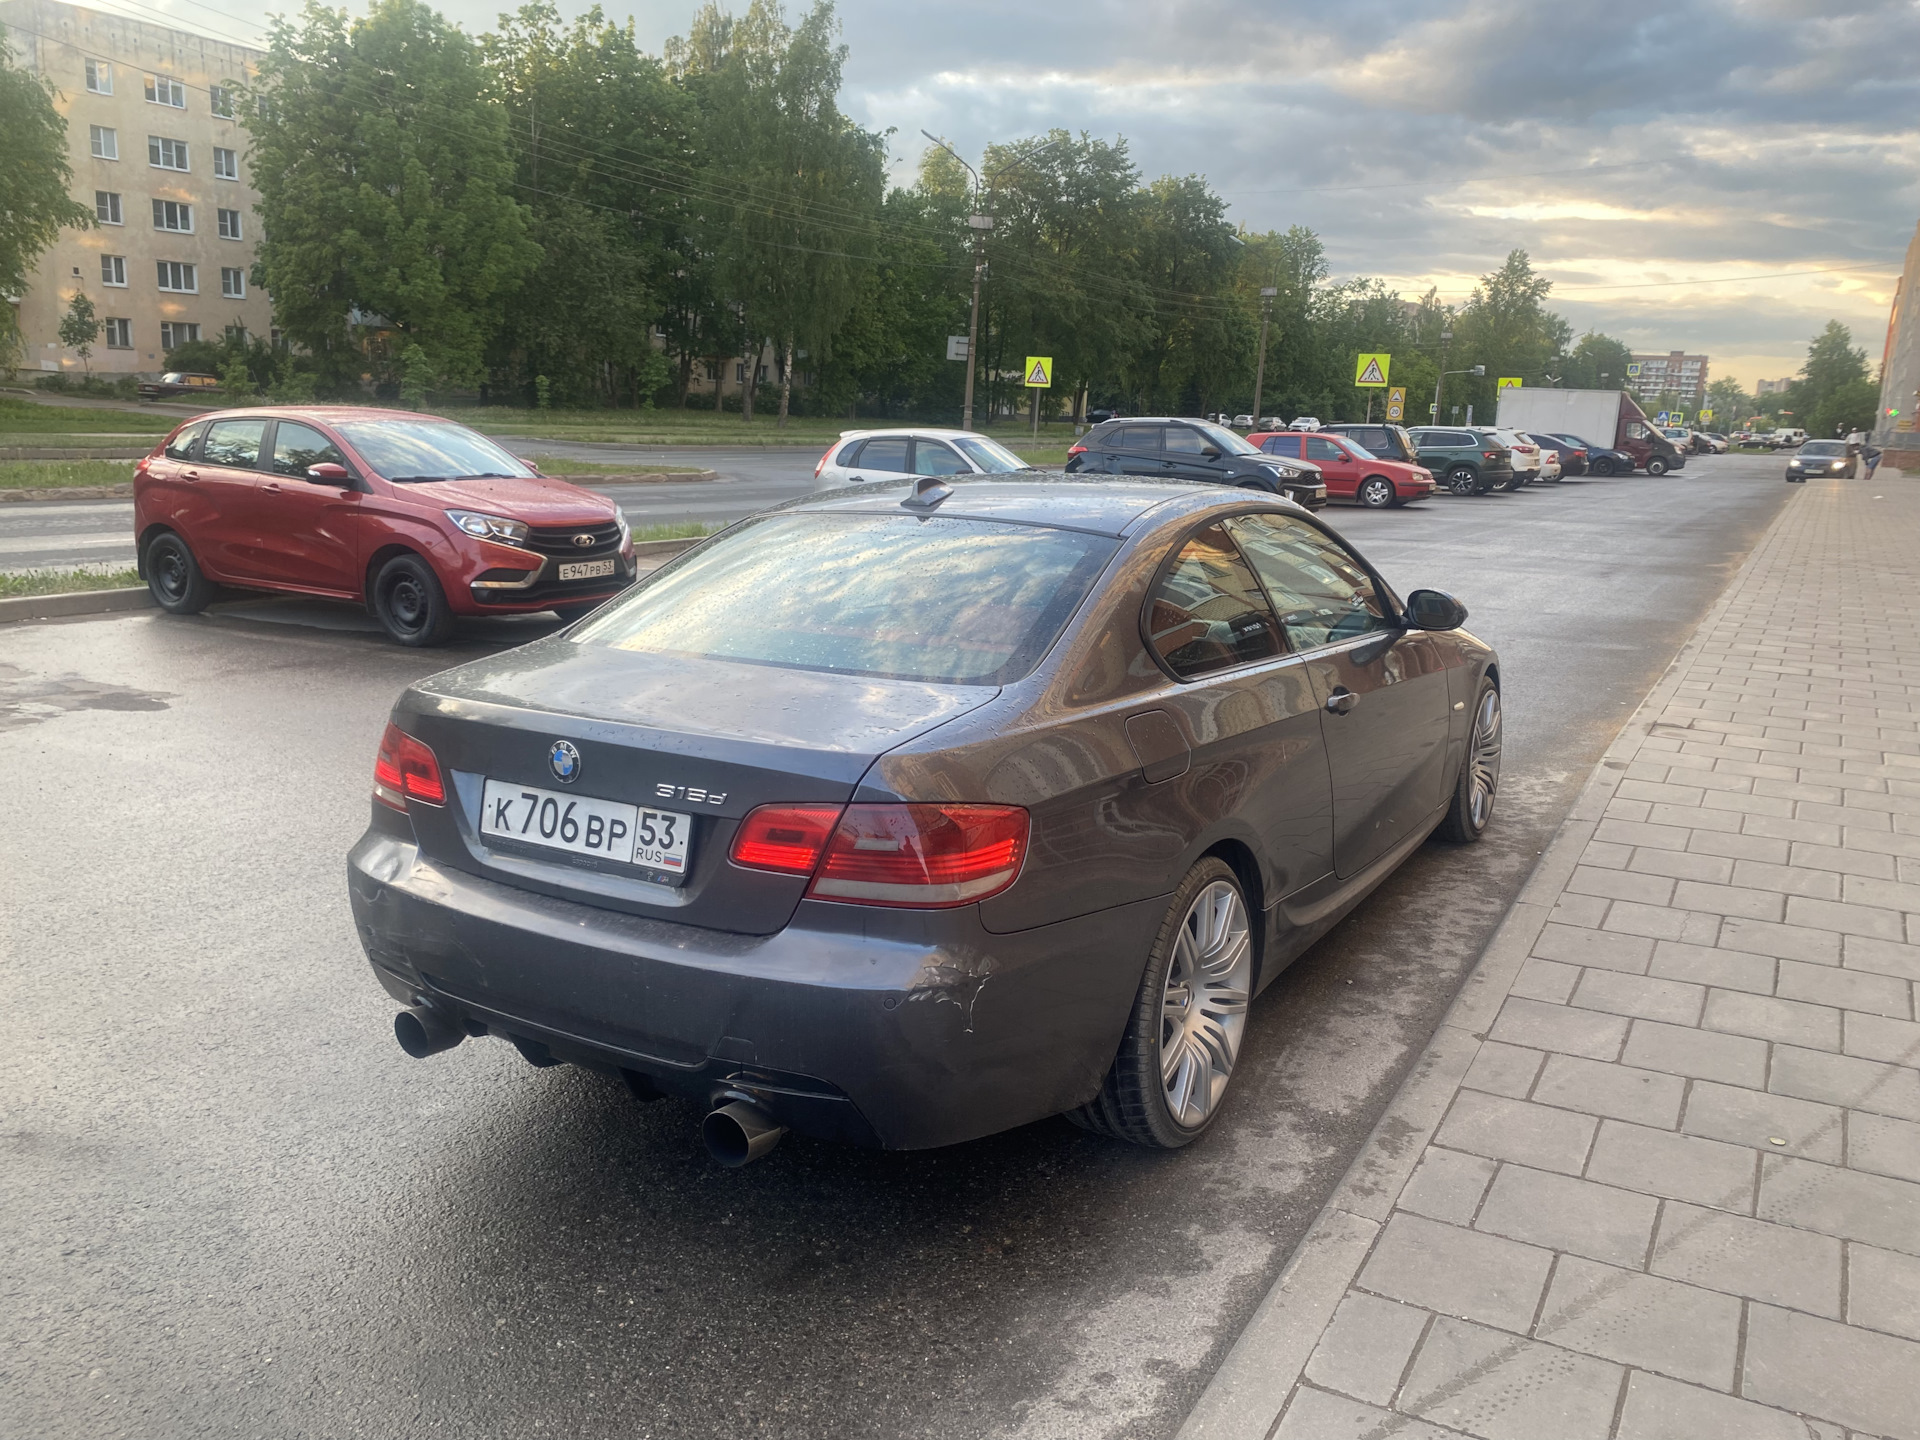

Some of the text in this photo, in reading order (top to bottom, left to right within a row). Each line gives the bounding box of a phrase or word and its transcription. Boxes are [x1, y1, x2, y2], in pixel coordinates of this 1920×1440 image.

[603, 561, 612, 571] 53
[551, 742, 577, 759] BMW
[494, 792, 678, 852] К706ВР 53
[635, 848, 662, 864] RUS
